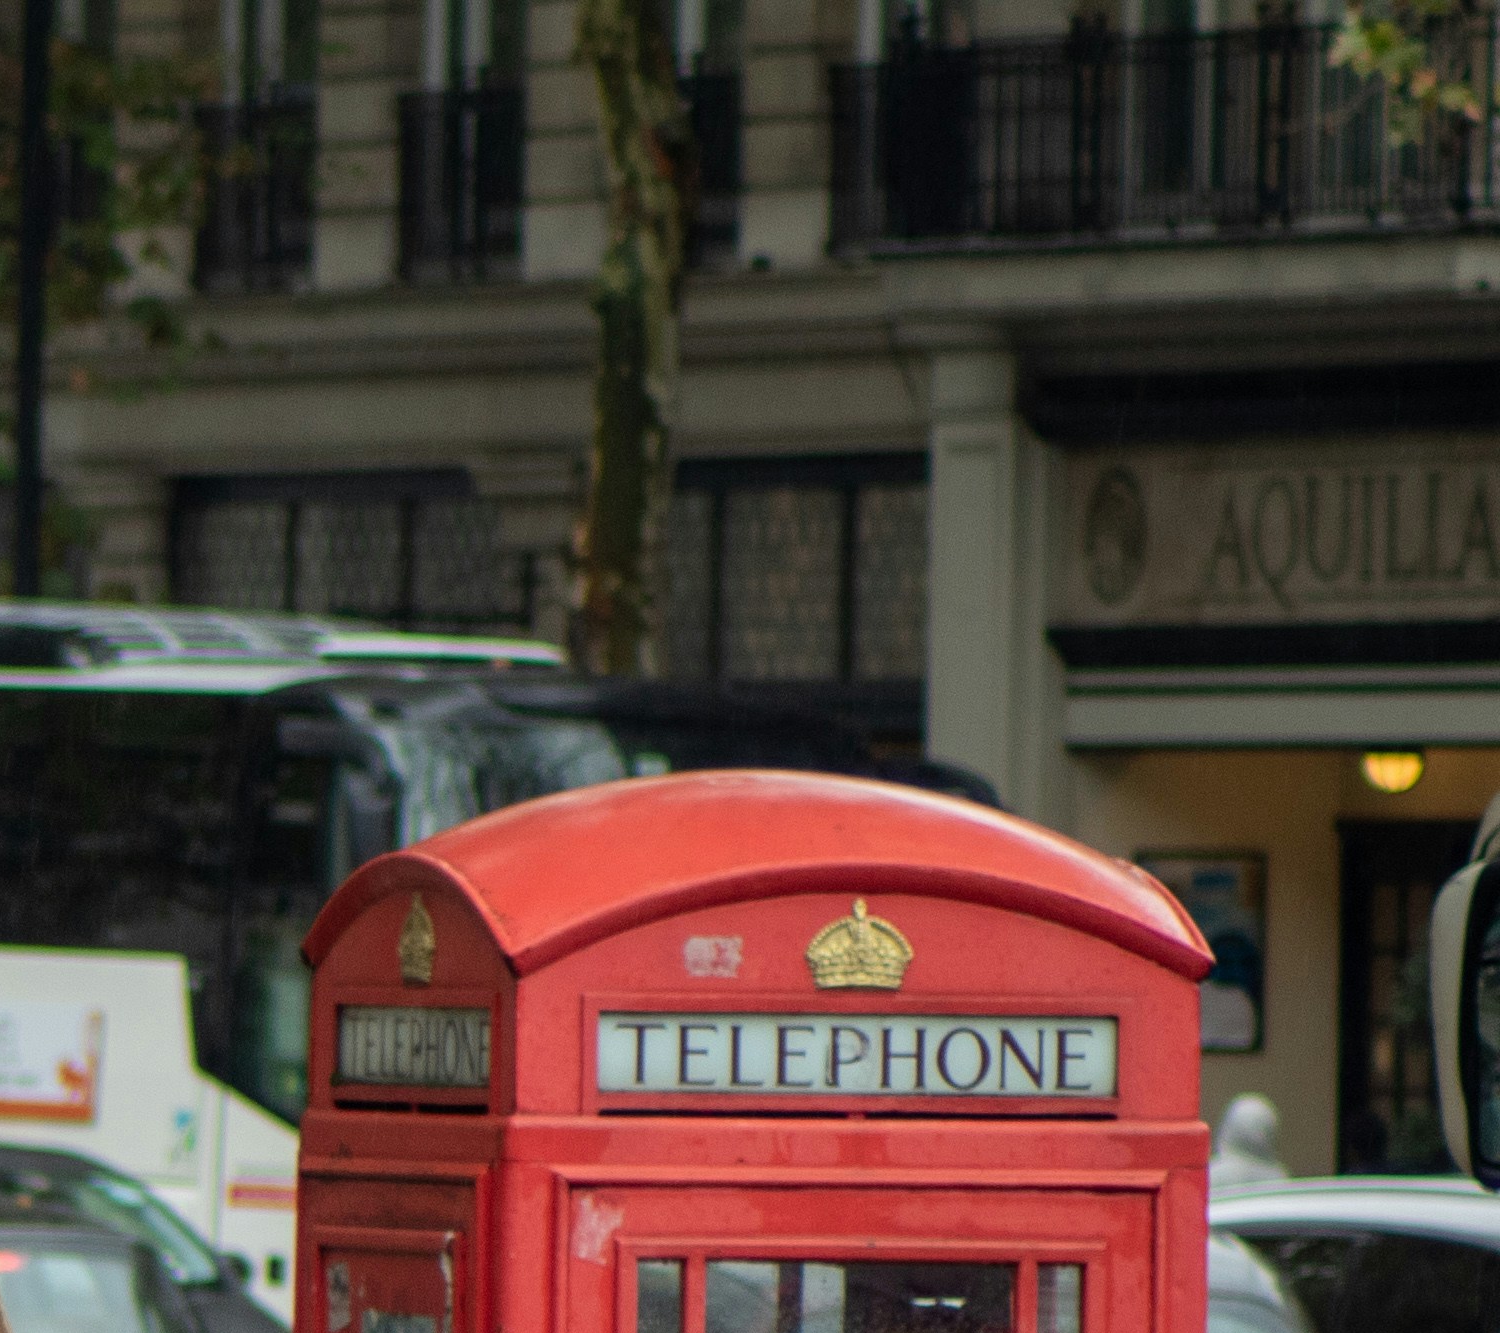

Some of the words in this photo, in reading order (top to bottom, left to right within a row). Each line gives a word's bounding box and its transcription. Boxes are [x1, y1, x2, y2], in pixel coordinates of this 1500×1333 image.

[1201, 472, 1500, 610] AQUILLA
[348, 1014, 491, 1083] TELEPHONE
[615, 1021, 1094, 1092] TELEPHONE
